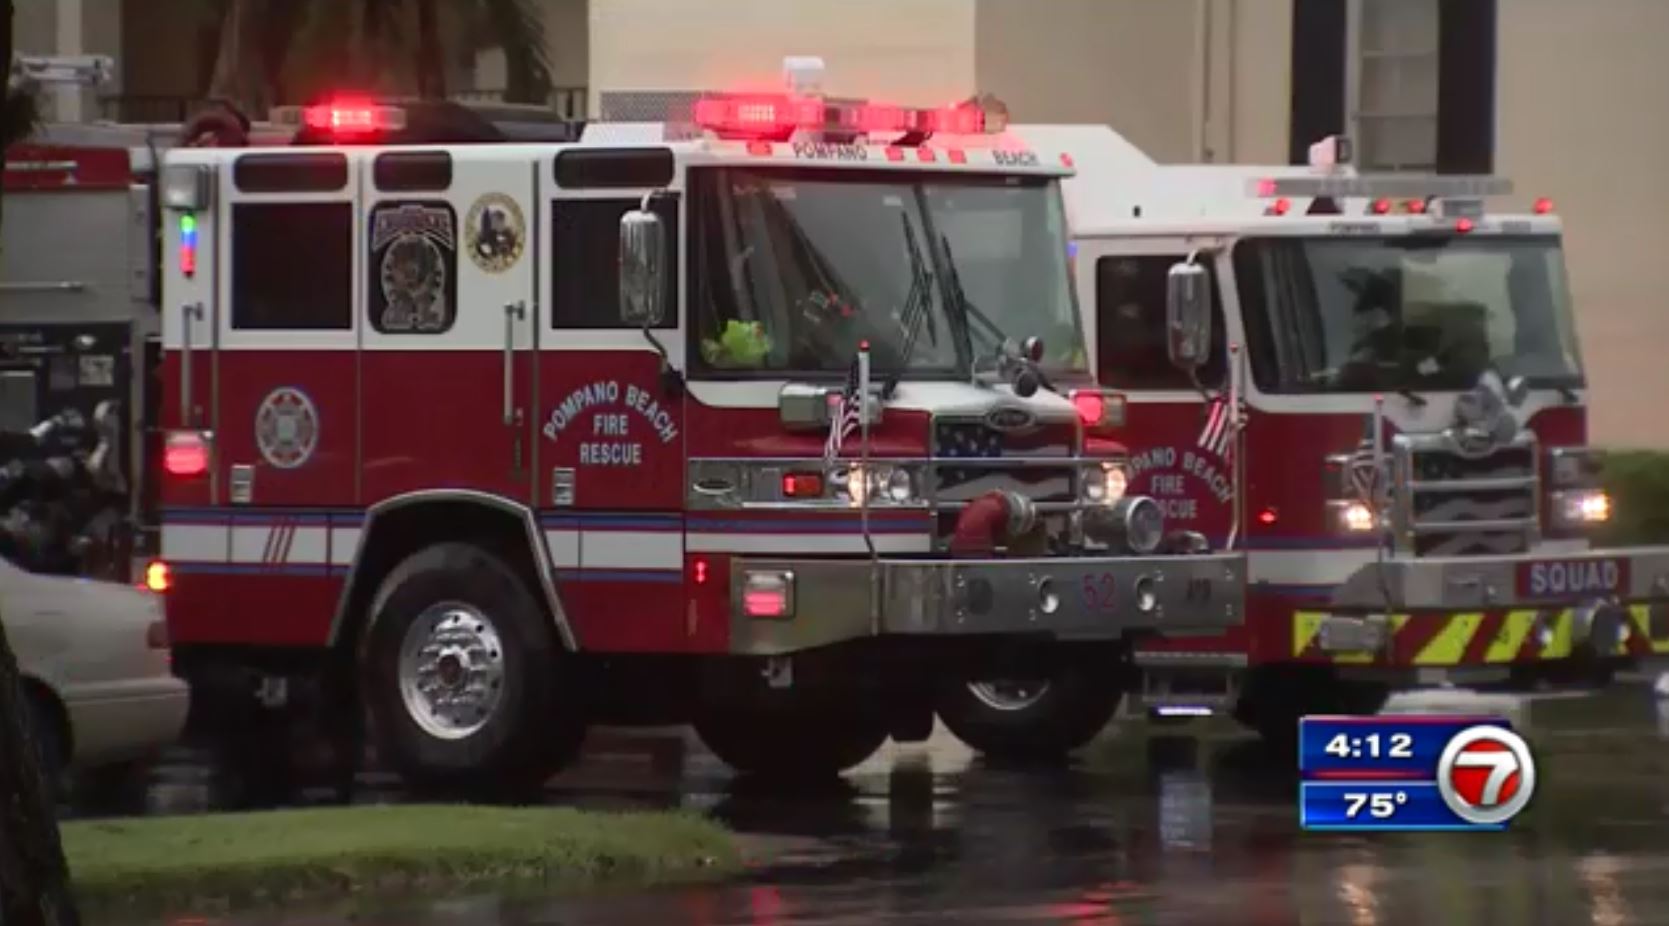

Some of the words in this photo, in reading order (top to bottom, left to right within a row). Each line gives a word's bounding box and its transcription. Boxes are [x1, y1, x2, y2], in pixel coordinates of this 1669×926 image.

[793, 143, 869, 160] POMPANO
[992, 150, 1038, 166] BEACH
[543, 380, 618, 442] POMPANO
[625, 384, 678, 442] BEACH
[593, 414, 629, 435] FIRE
[580, 443, 642, 464] RESCUE
[1150, 475, 1185, 495] FIRE
[1183, 451, 1232, 503] BEACH
[1530, 561, 1618, 593] SQUAD
[1082, 572, 1116, 610] 52
